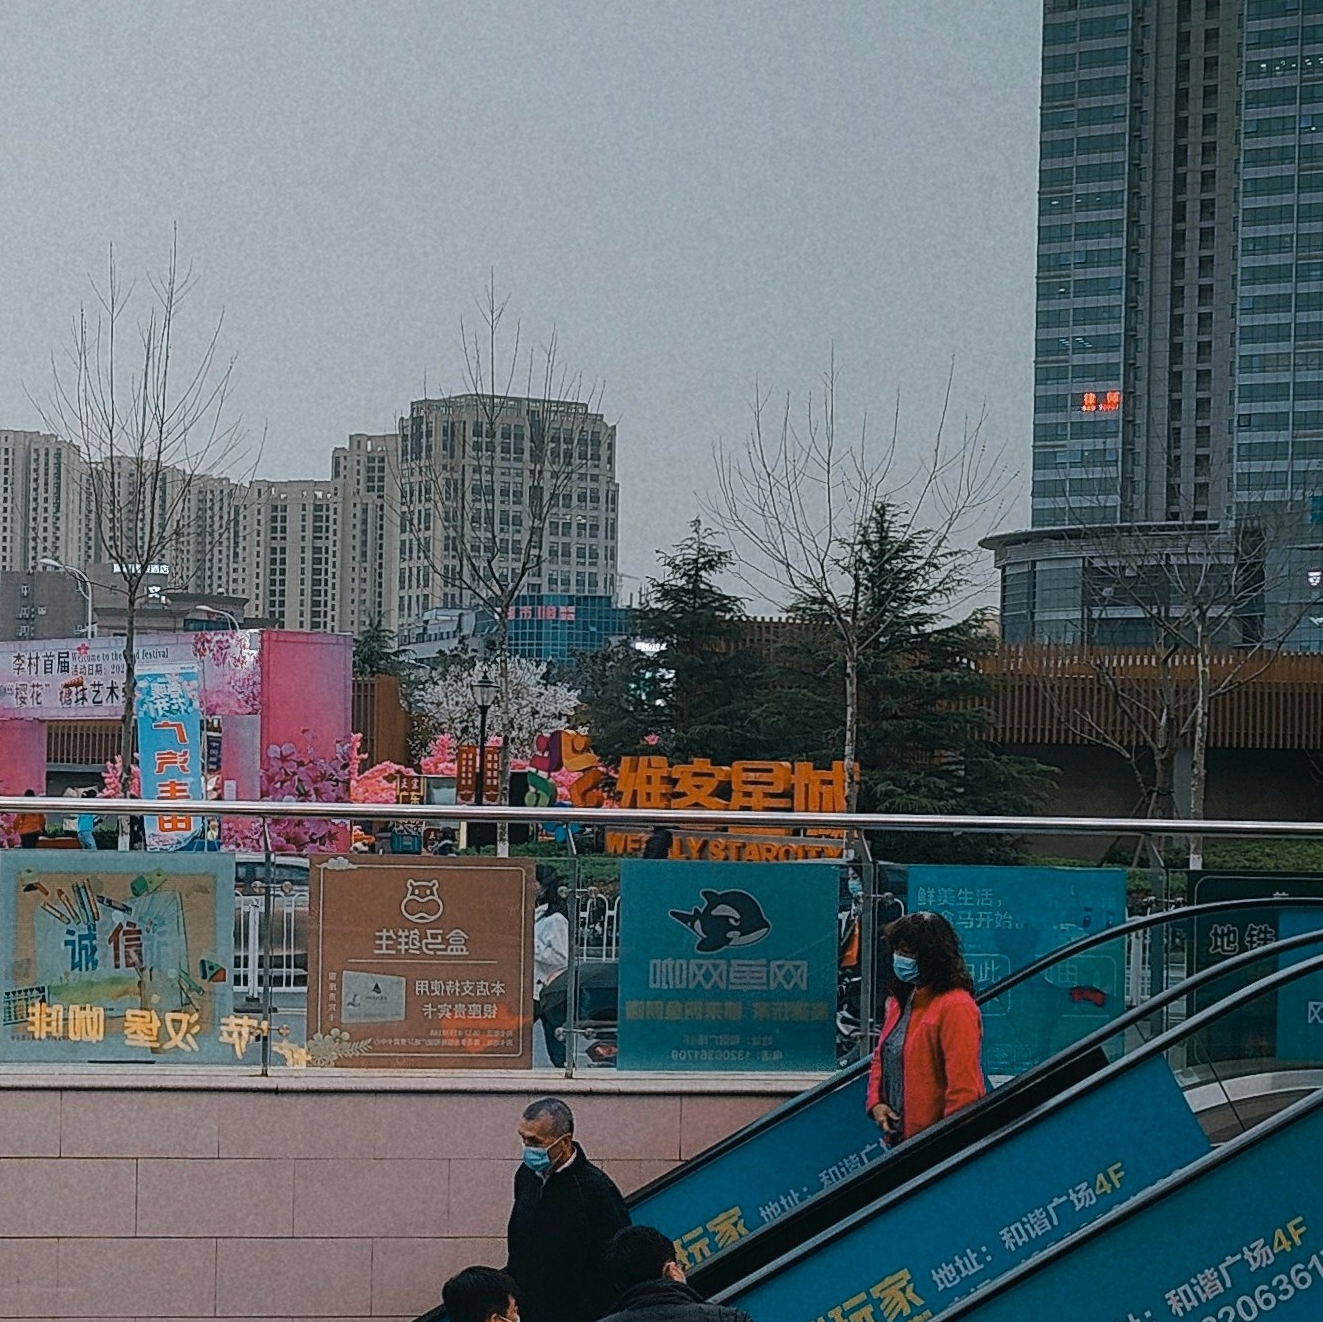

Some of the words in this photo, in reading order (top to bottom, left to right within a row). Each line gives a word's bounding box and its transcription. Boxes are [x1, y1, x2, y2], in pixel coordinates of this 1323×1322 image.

[12, 650, 71, 676] 李村首届
[71, 651, 101, 663] Welcome
[141, 647, 169, 661] festival
[63, 920, 144, 973] 诚信
[1209, 923, 1277, 956] 地铁
